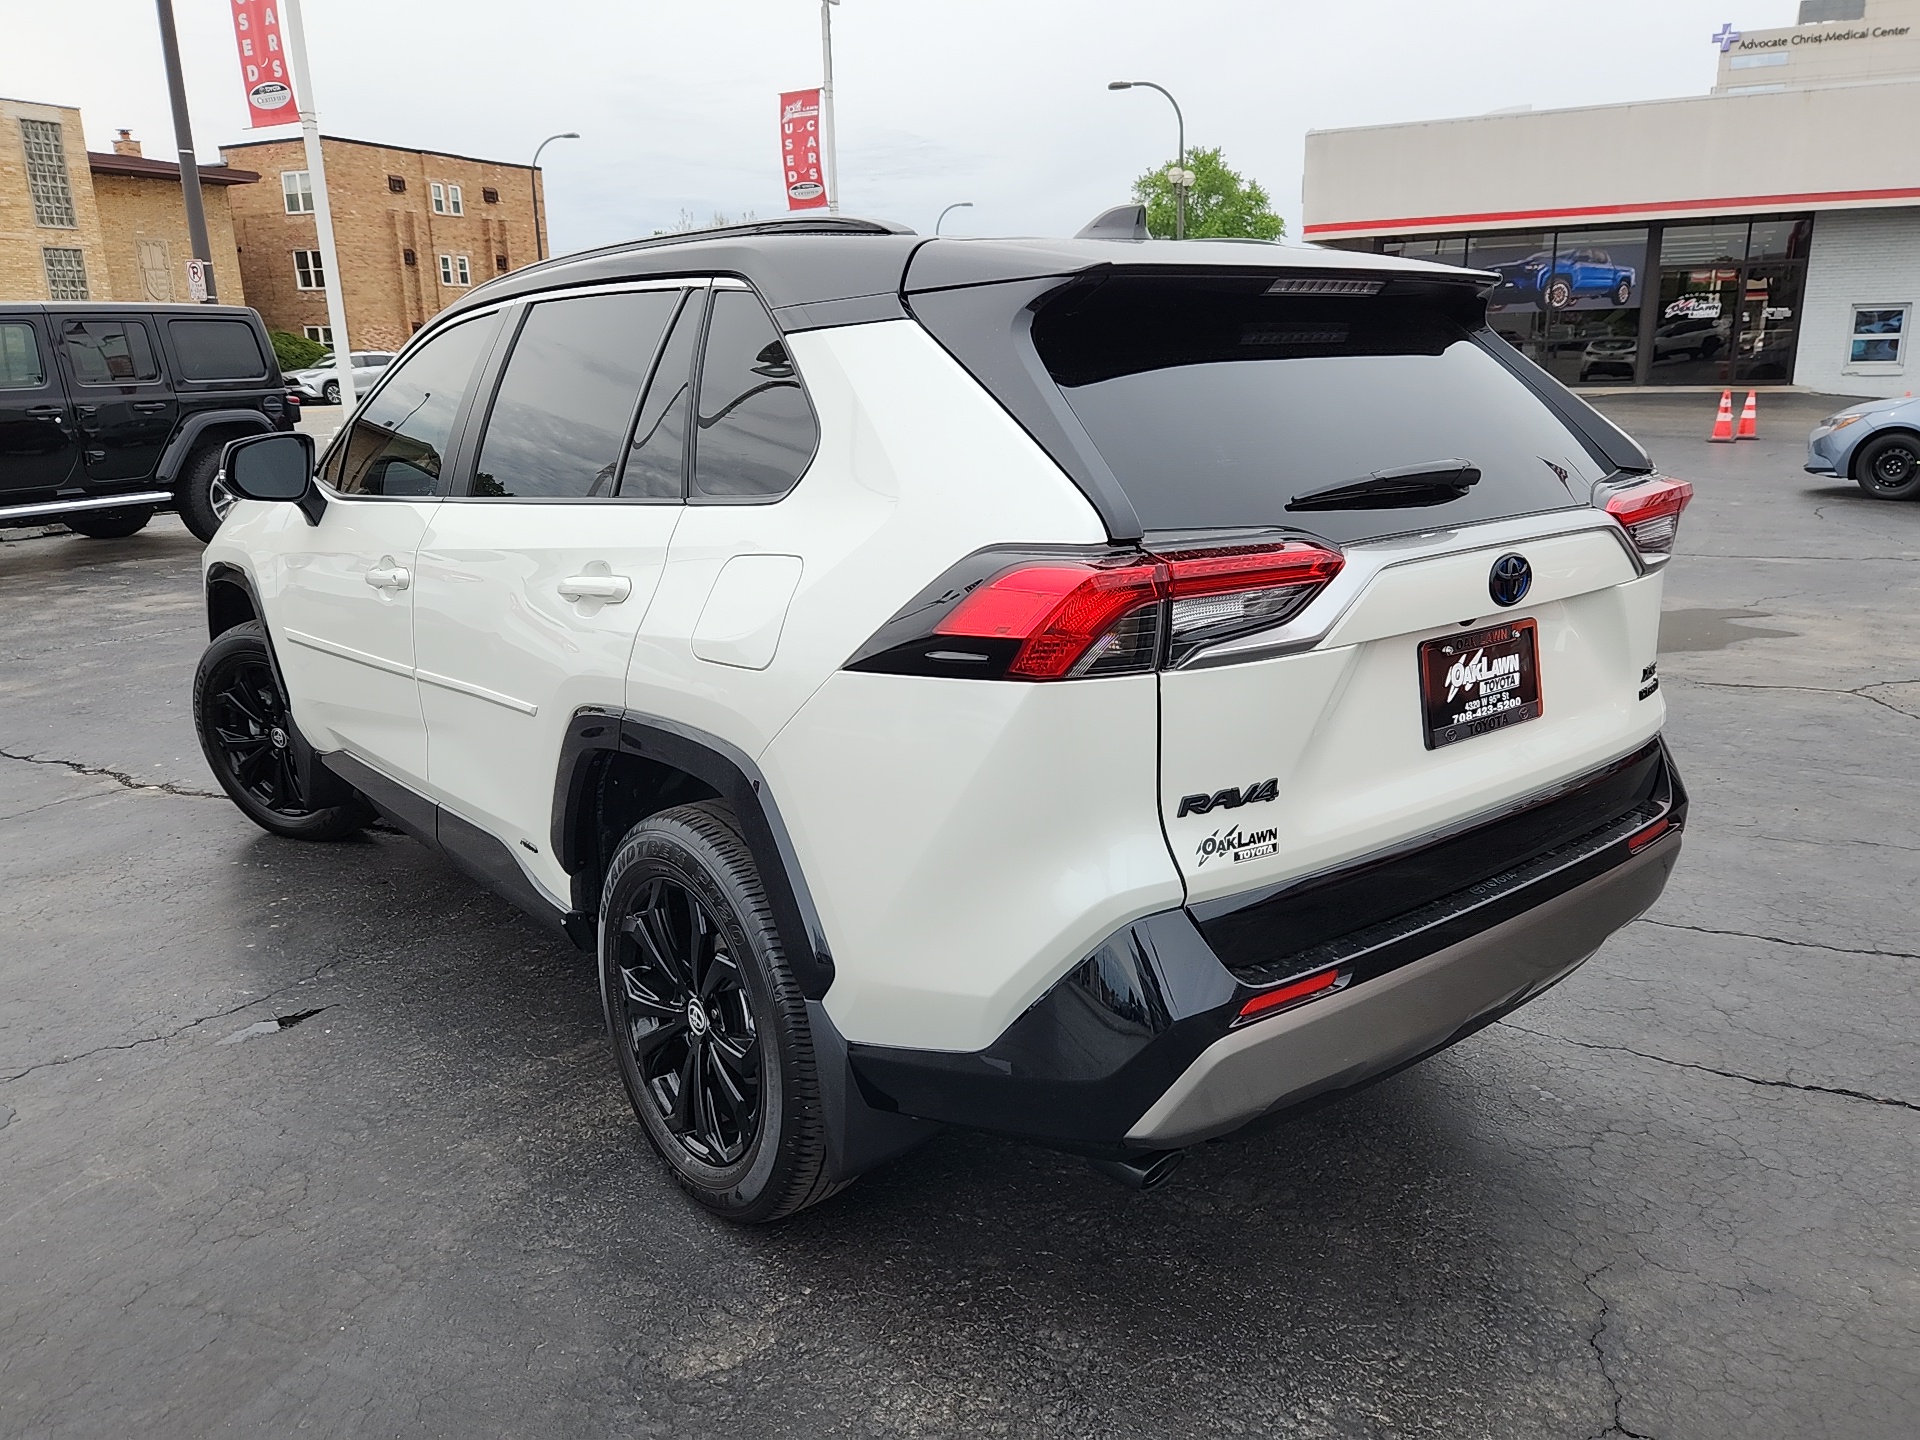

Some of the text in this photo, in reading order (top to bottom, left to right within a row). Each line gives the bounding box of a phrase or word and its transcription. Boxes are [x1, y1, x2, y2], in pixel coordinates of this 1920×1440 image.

[236, 0, 259, 82] SED
[264, 7, 283, 78] ARS
[1738, 26, 1911, 50] Advocate Christ Medical Center
[784, 122, 798, 183] USED
[806, 120, 819, 180] CARS
[1456, 628, 1508, 649] OAK LAWN
[1484, 675, 1516, 693] TOYOTA
[1452, 697, 1521, 724] 708-423-5200
[1464, 700, 1480, 711] 4320
[1481, 696, 1488, 706] W
[1501, 692, 1510, 700] St
[1467, 713, 1509, 735] TOYOTA
[1177, 777, 1280, 818] RAV4
[1237, 845, 1275, 860] TOYOTA
